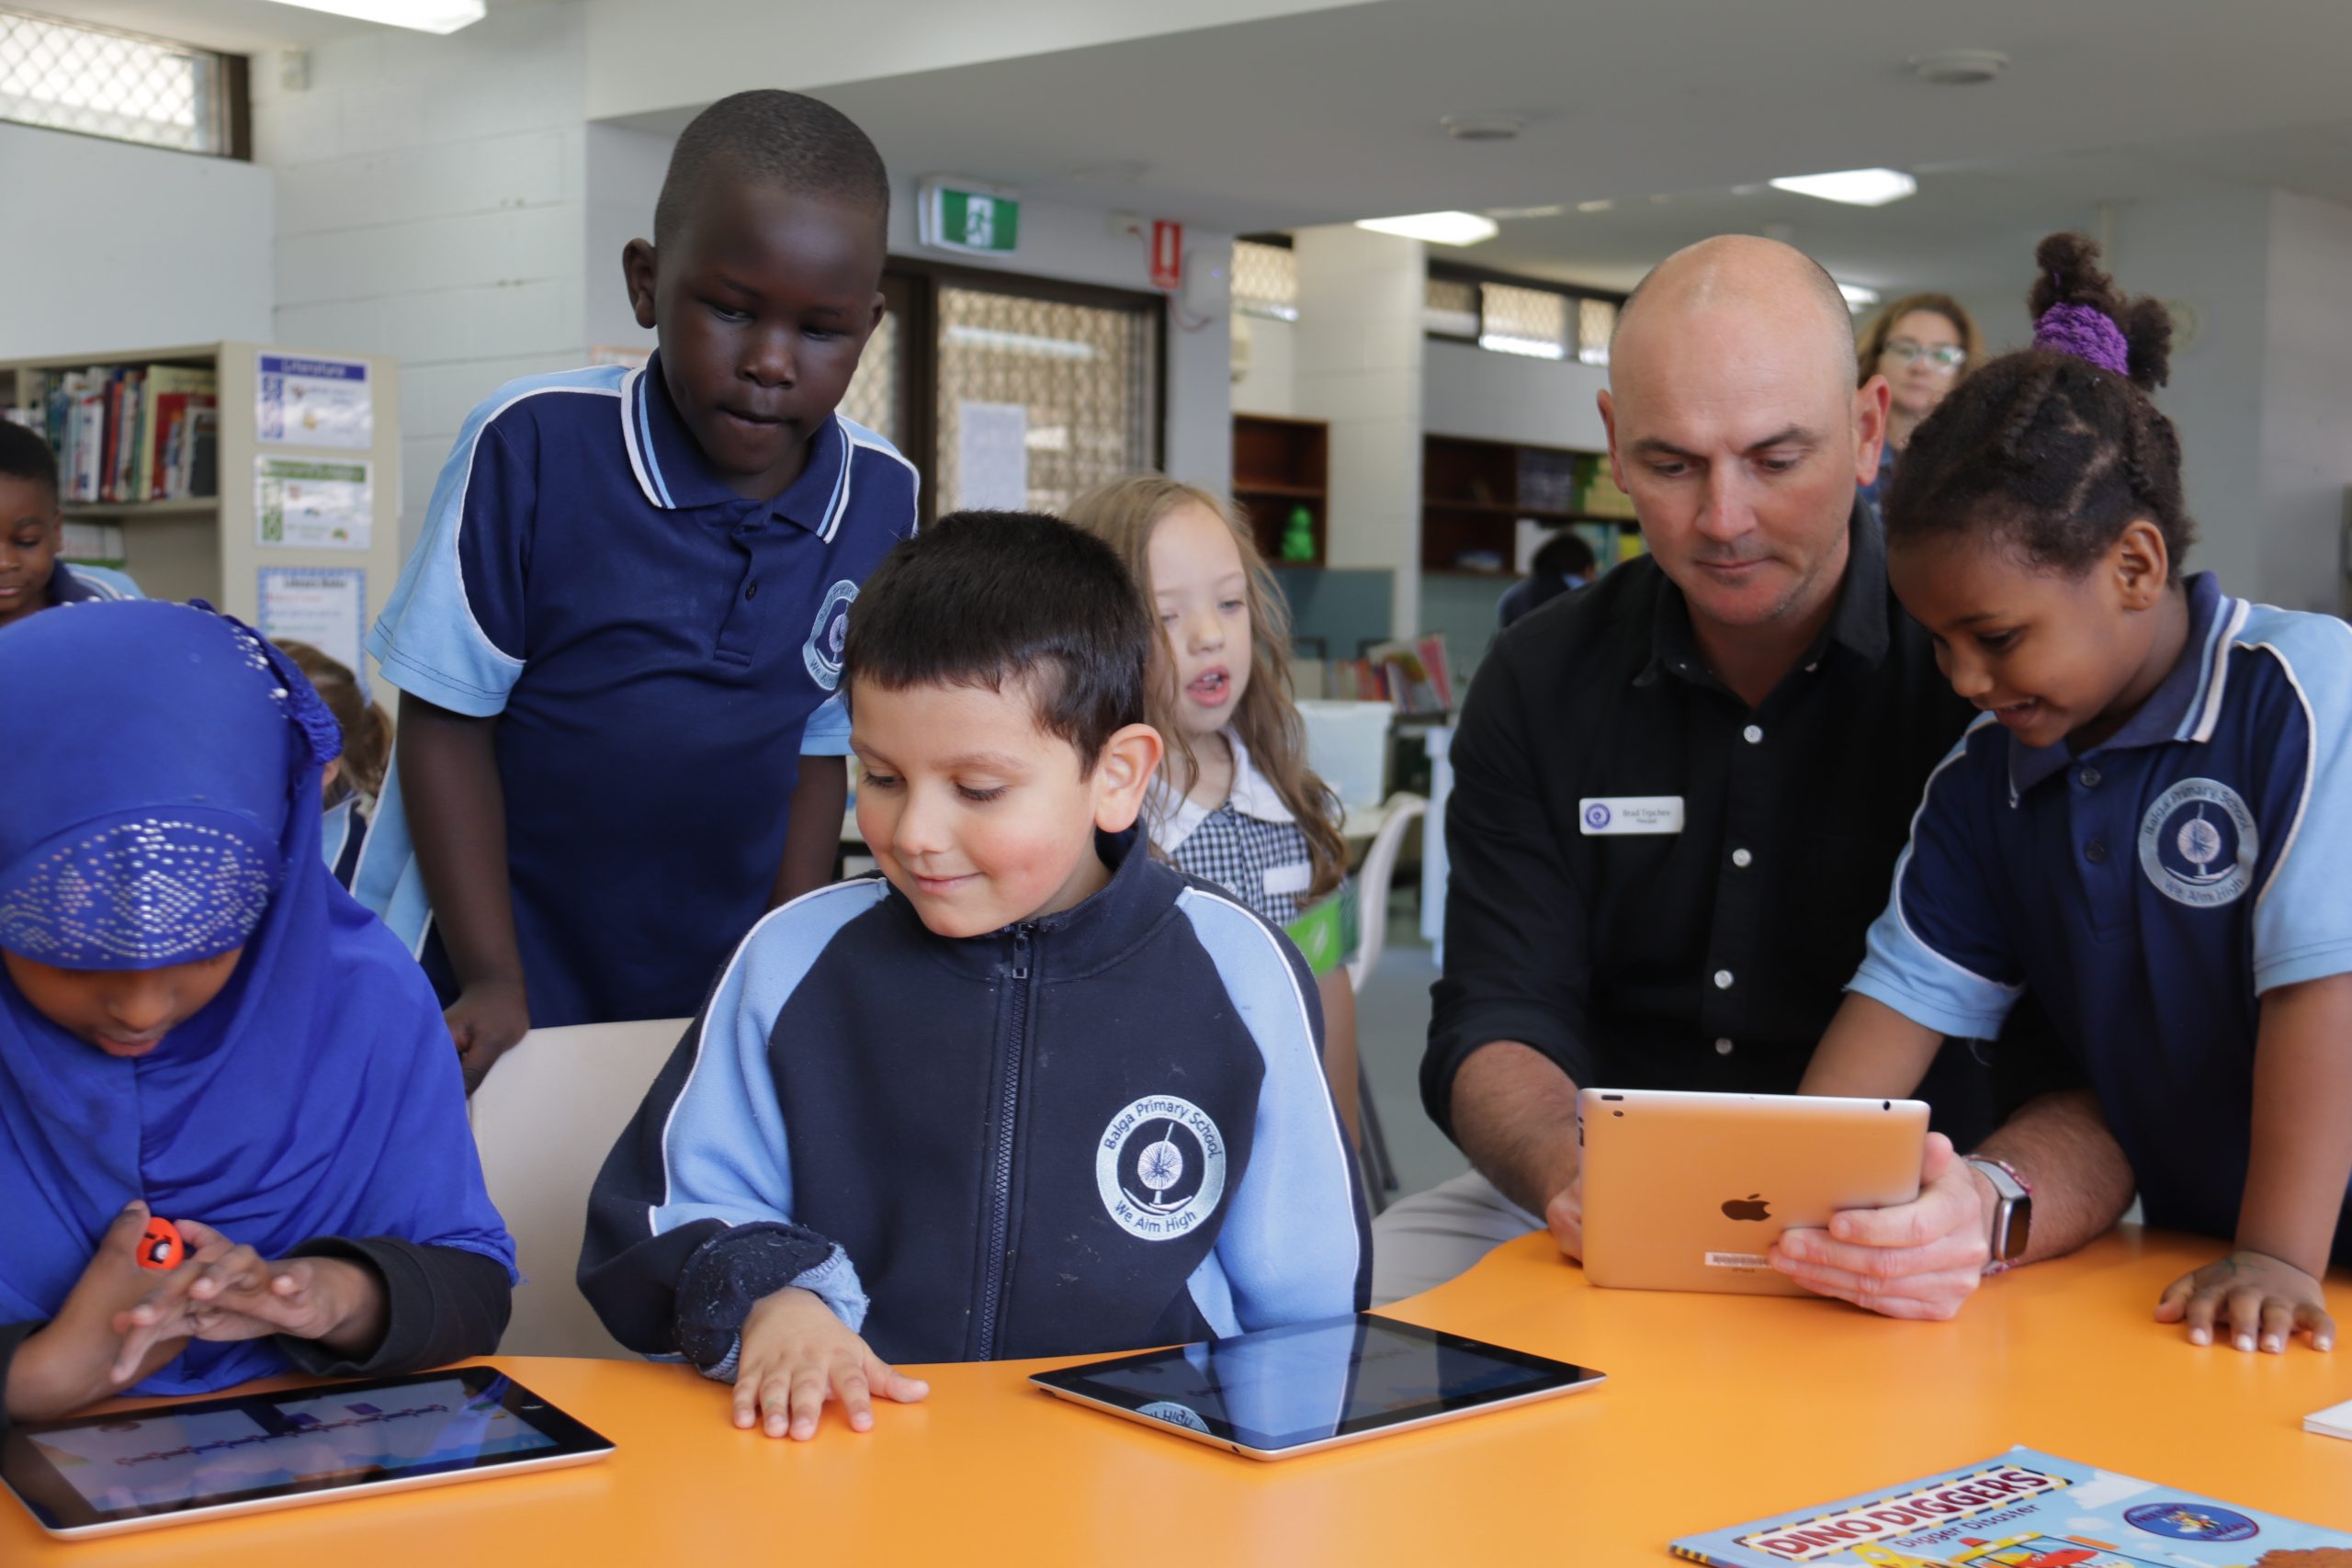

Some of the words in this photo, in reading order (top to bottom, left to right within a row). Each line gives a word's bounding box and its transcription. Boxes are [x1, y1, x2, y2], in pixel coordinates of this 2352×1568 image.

[1104, 1112, 1136, 1150] Balga
[1136, 1100, 1190, 1118] Primary
[1189, 1112, 1222, 1158] School
[1114, 1201, 1133, 1223] We
[1134, 1217, 1161, 1233] Aim
[1166, 1210, 1197, 1233] High
[1757, 1518, 1883, 1554] DINO
[1866, 1471, 2049, 1527] DIGGERS
[1893, 1526, 1962, 1548] Digger
[1961, 1504, 2041, 1530] Disaster
